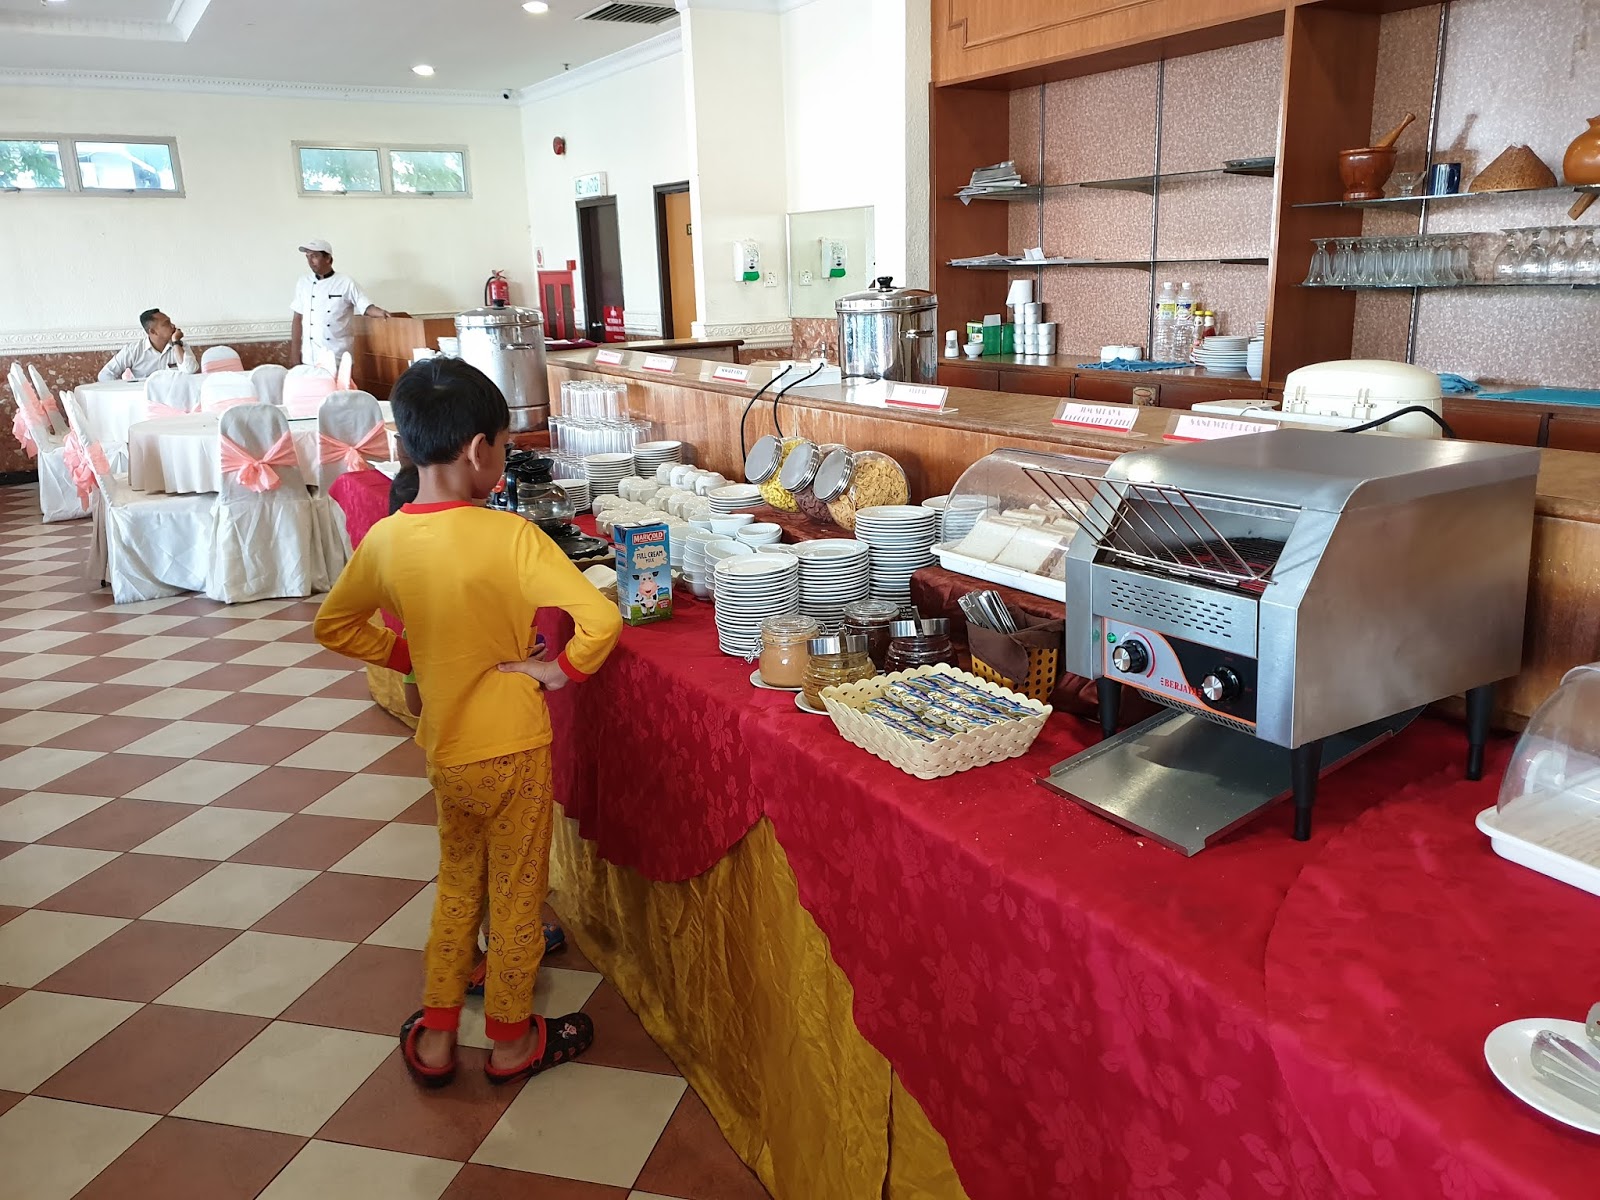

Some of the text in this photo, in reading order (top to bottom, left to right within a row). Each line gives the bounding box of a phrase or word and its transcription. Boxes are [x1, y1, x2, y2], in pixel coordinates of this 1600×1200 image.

[633, 531, 664, 543] MARIGOLD
[636, 550, 664, 560] FULL CREAM
